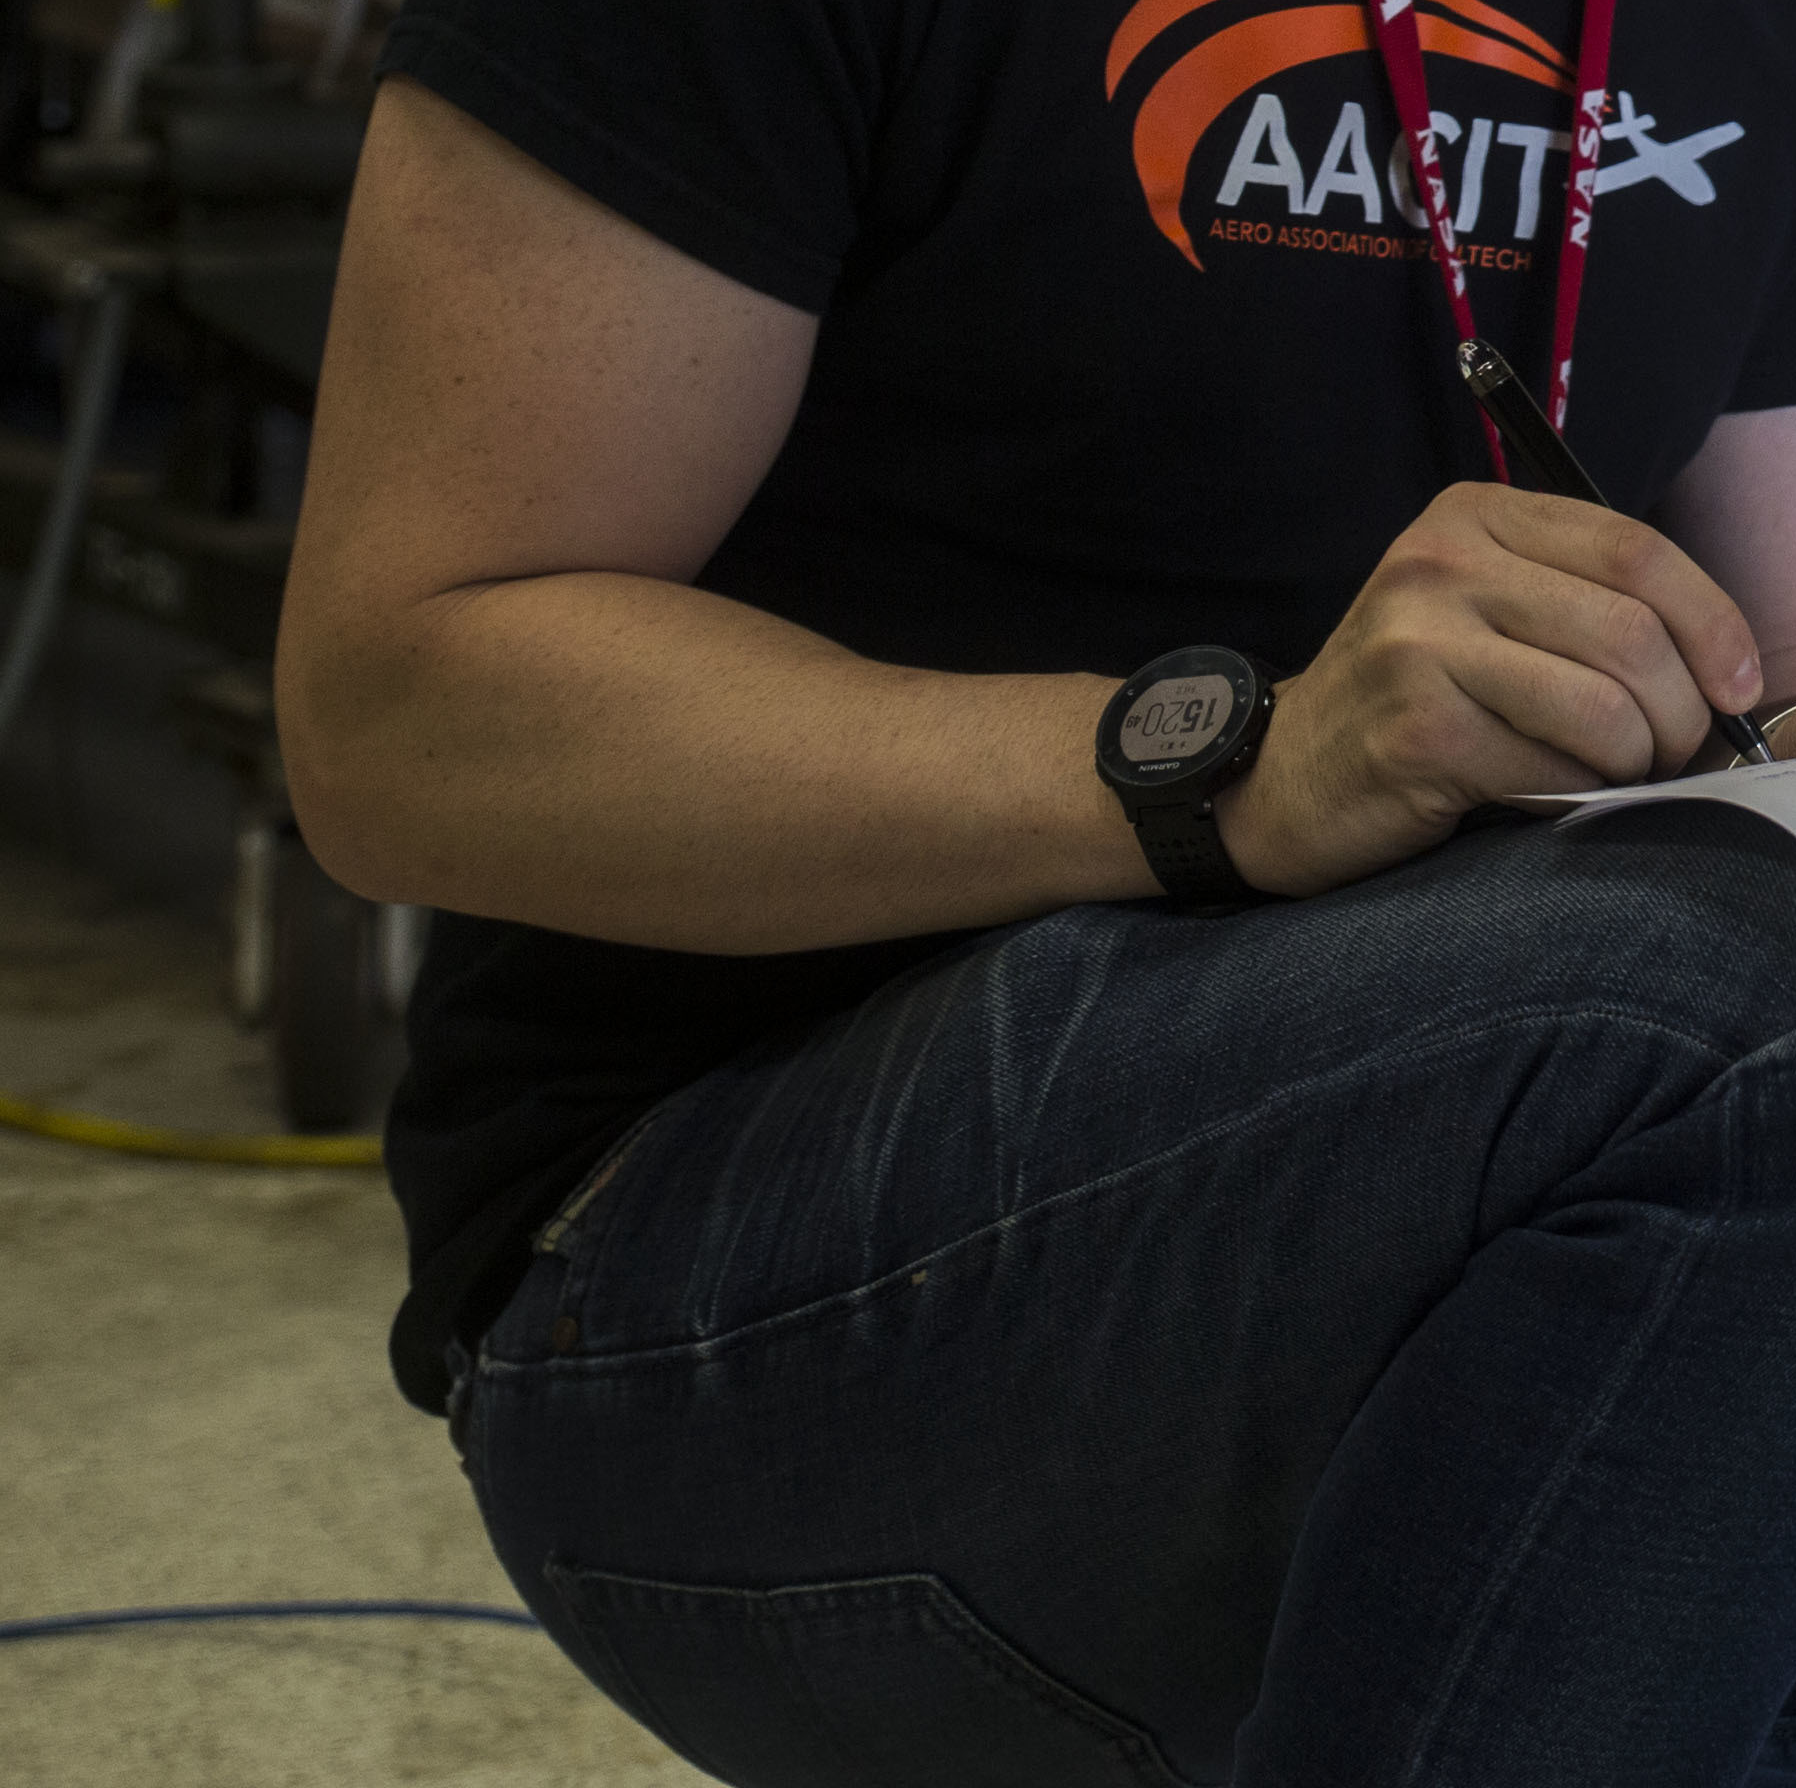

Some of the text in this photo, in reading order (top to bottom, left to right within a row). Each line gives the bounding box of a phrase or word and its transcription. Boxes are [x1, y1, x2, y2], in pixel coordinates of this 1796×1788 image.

[1570, 88, 1606, 251] NASA
[1208, 217, 1273, 246] AERO
[1276, 224, 1407, 260] ASSOCIATION
[1125, 697, 1218, 737] 1520 49
[1138, 761, 1181, 774] GARMIN
